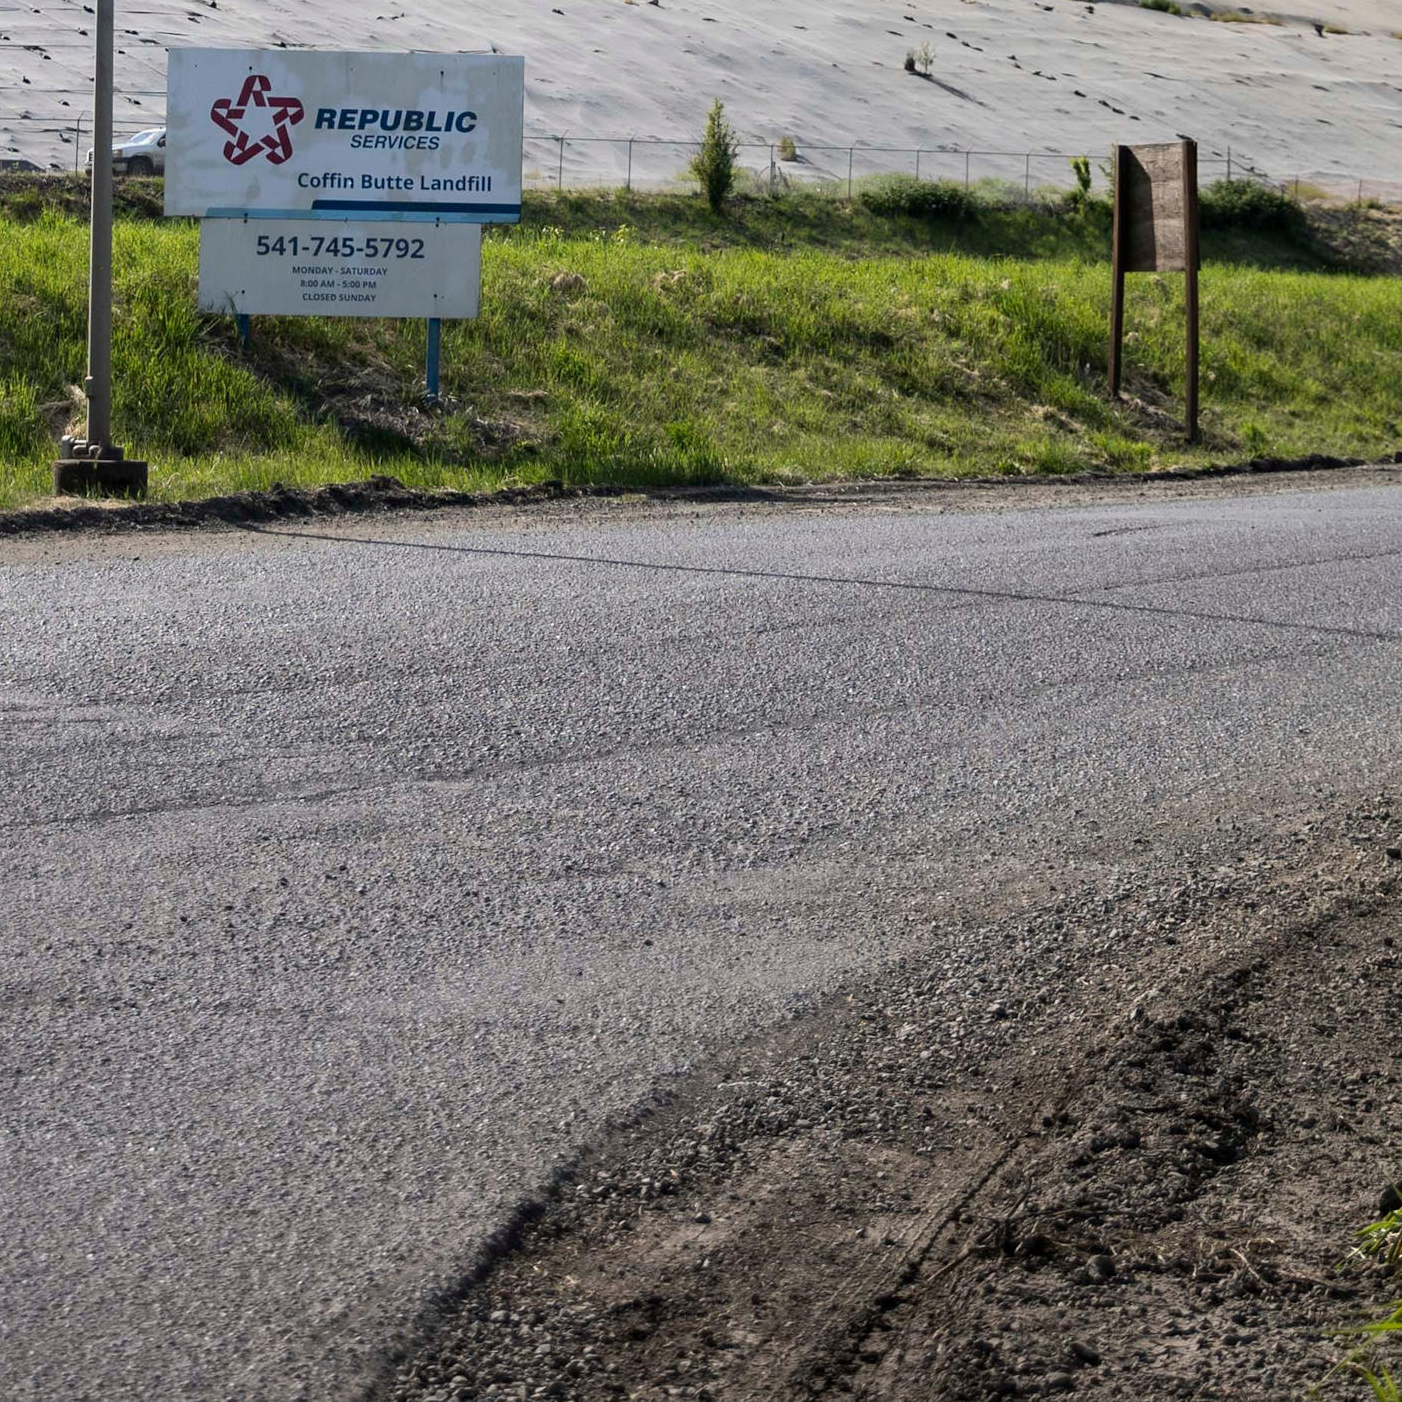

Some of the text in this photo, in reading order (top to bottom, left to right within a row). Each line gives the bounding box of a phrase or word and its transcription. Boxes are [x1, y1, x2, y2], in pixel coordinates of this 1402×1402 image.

[314, 108, 478, 133] REPUBLIC
[350, 134, 440, 150] SERVICES
[297, 172, 492, 192] Coffin Butte Landfill
[256, 235, 425, 259] 541-745-5792
[292, 266, 333, 275] MONDAY
[340, 267, 388, 276] SATURDAY
[300, 279, 318, 288] 8:00
[320, 280, 335, 288] AM
[342, 280, 360, 289] 5:00
[363, 281, 377, 289] PM
[302, 293, 376, 302] CLOSED SUNDAY
